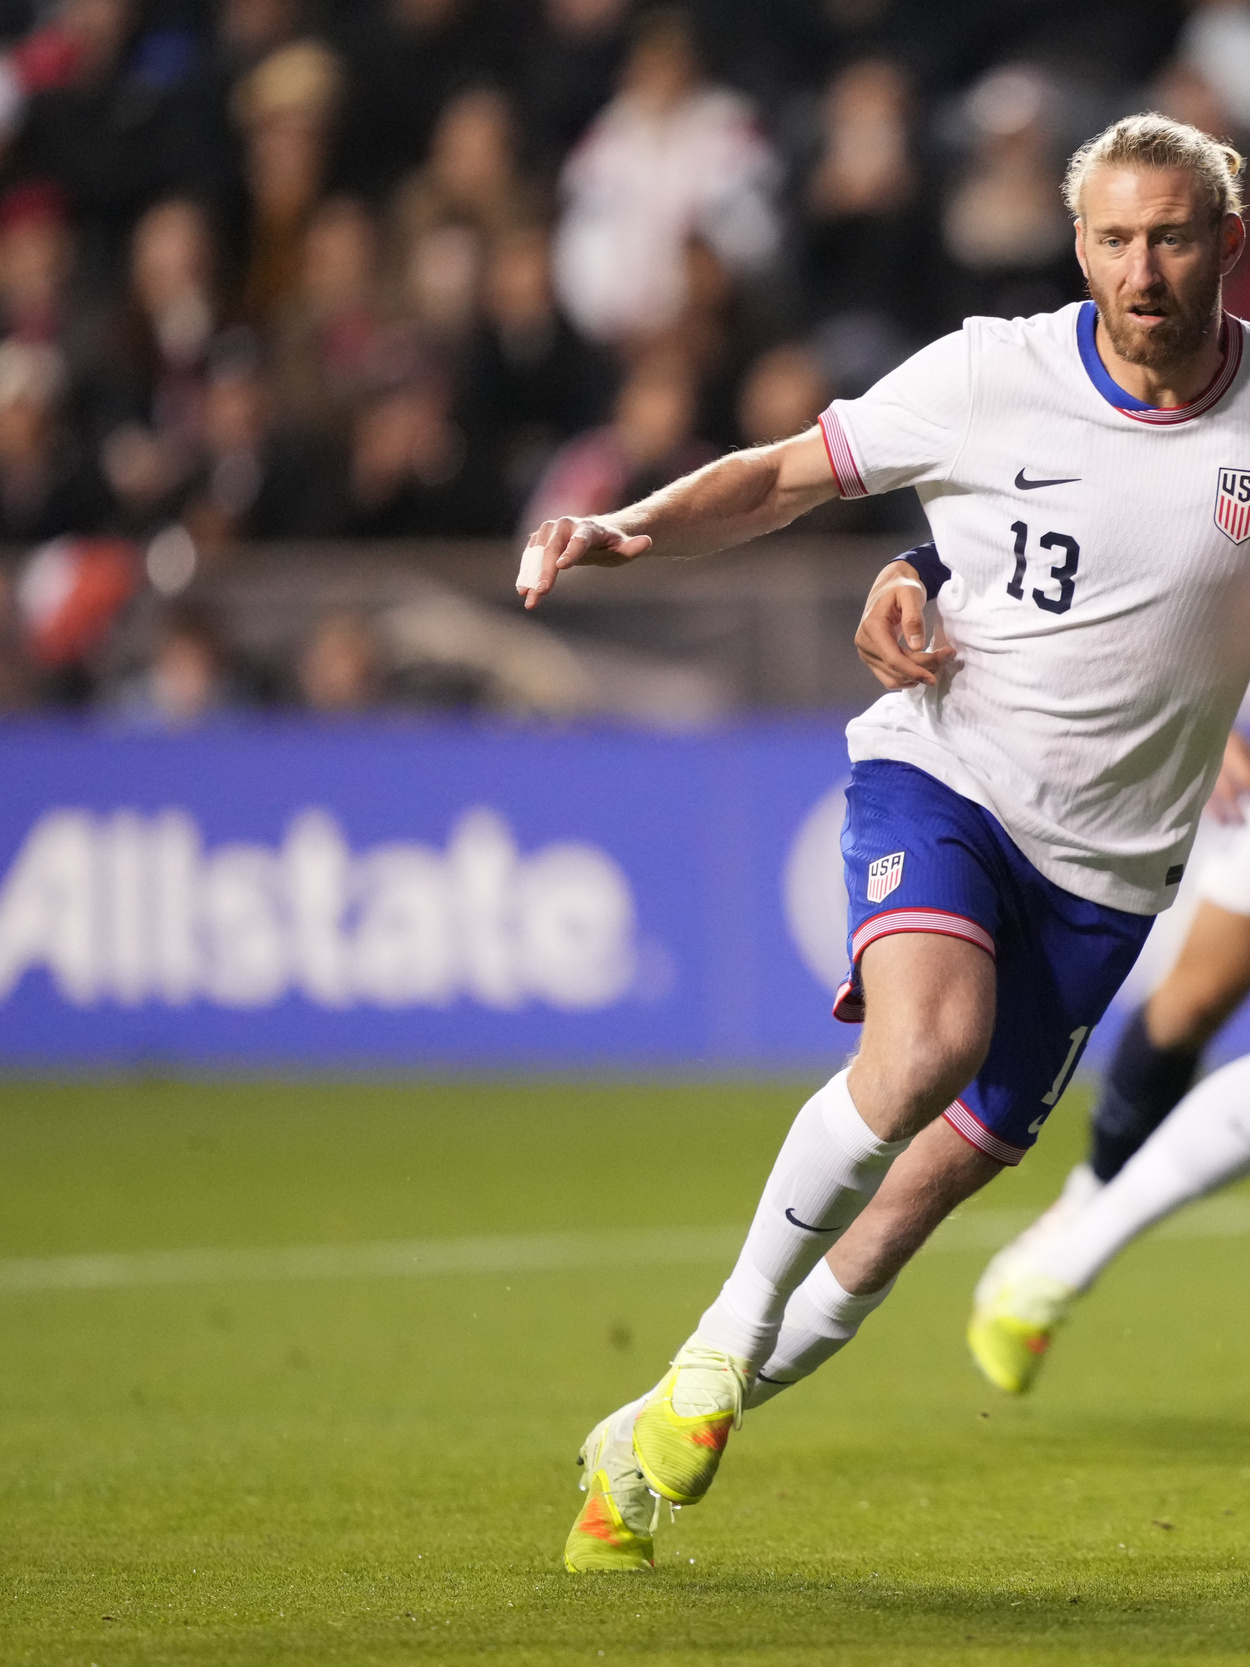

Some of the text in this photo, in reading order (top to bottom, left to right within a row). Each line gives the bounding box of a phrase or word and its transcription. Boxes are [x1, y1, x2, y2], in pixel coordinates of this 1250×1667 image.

[1006, 519, 1080, 615] 13
[0, 804, 634, 1011] Allstate
[870, 855, 902, 878] USA
[1041, 1023, 1097, 1106] 1
